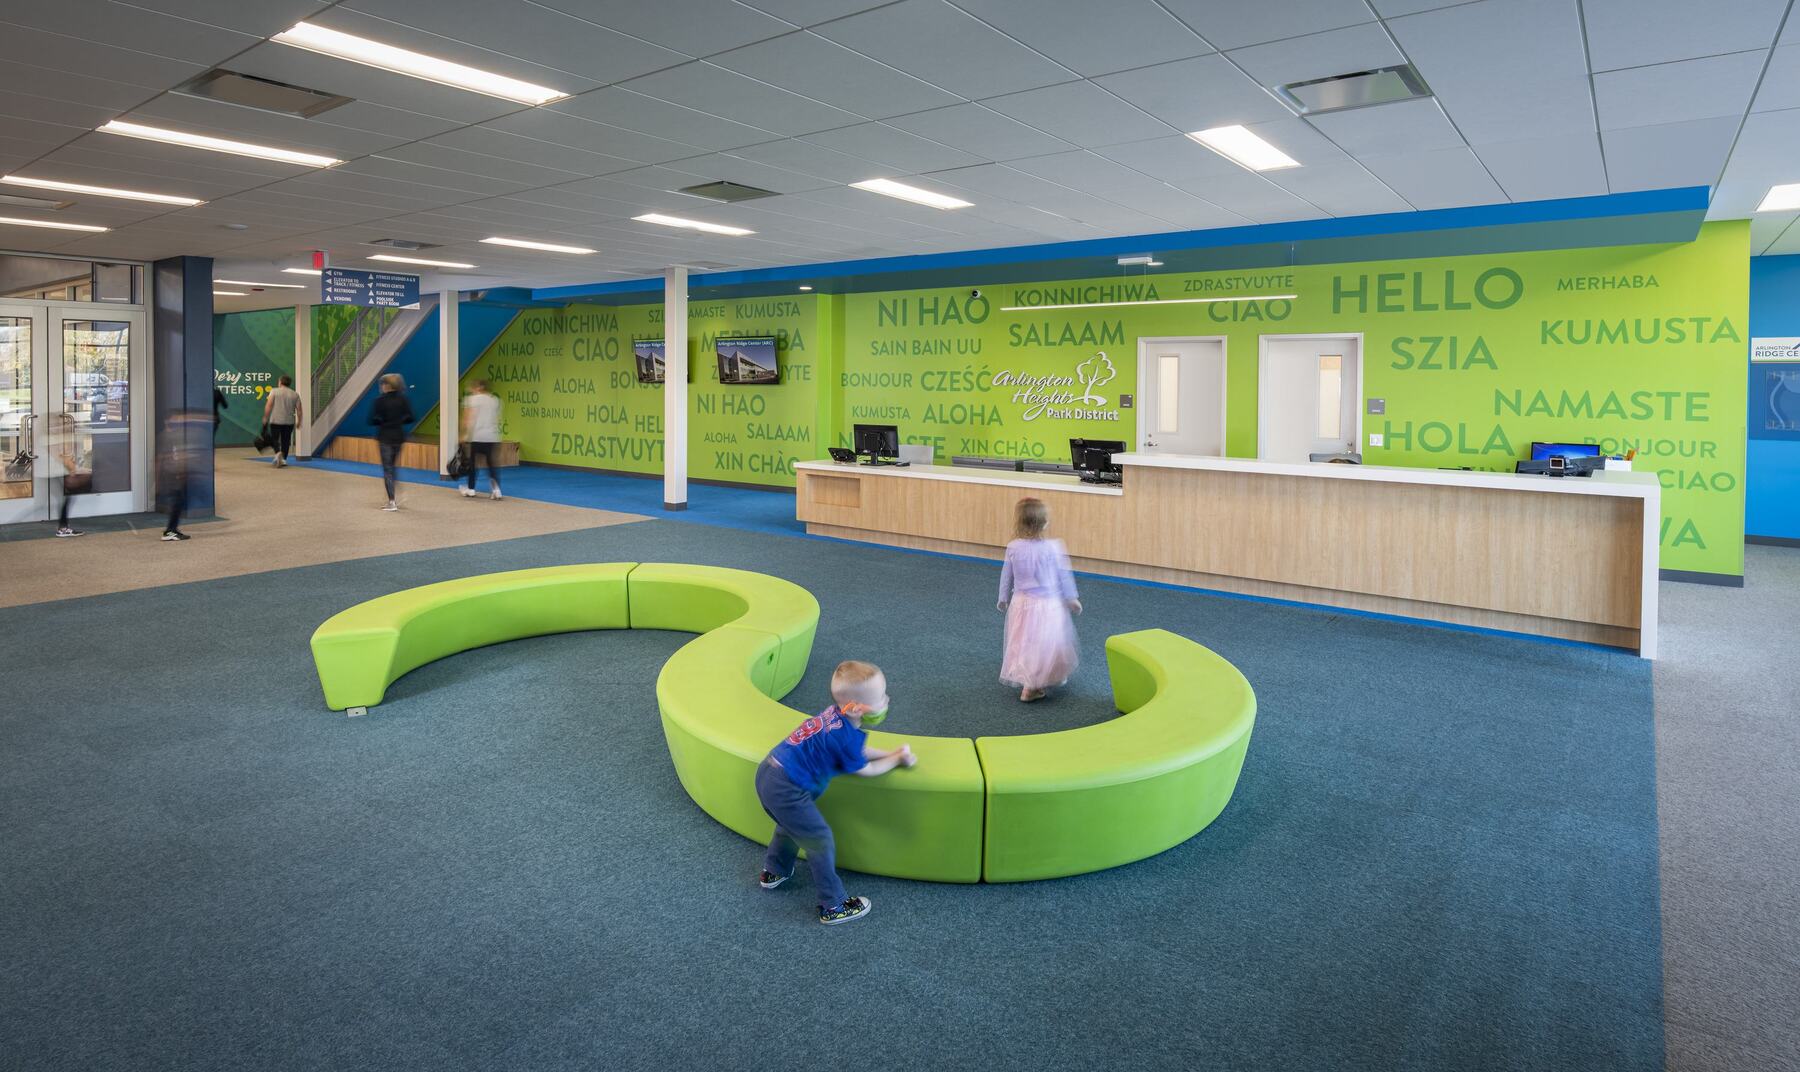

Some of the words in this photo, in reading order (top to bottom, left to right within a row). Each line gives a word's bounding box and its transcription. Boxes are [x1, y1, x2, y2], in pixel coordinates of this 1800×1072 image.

[1184, 275, 1295, 292] ZDRASTVUYTE
[1332, 266, 1524, 314] HELLO
[1557, 275, 1660, 291] MERHABA
[1014, 283, 1161, 307] KONNICHIWA
[648, 309, 665, 323] SZI
[688, 305, 726, 319] AMASTE
[736, 302, 801, 319] KUMUSTA
[878, 298, 908, 327] NI
[919, 295, 990, 325] HAO
[1208, 298, 1292, 322] CIAO
[523, 314, 619, 335] KONNICHIWA
[1009, 320, 1125, 347] SALAAM
[1541, 316, 1741, 345] KUMUSTA
[498, 343, 509, 356] NI
[512, 342, 535, 356] HAO
[572, 337, 619, 361] CIAO
[871, 340, 907, 355] SAIN
[912, 339, 952, 355] BAIN
[957, 338, 982, 354] UU
[1391, 335, 1498, 370] SZIA
[245, 372, 272, 382] STEP
[488, 364, 541, 383] SALAAM
[841, 372, 913, 388] BONJOUR
[920, 365, 992, 392] CZEŚĆ
[992, 369, 1075, 393] Arlington
[553, 378, 596, 394] ALOHA
[508, 391, 540, 404] HALLO
[697, 394, 716, 414] NI
[722, 394, 766, 416] HAO
[1011, 386, 1075, 421] Heights
[1494, 388, 1711, 422] NAMASTE
[521, 407, 540, 418] SAIN
[541, 408, 561, 419] BAIN
[562, 408, 575, 419] UU
[587, 405, 629, 424] HOLA
[852, 405, 911, 420] KUMUSTA
[922, 403, 1004, 426] ALOHA
[1047, 408, 1073, 420] Park
[1075, 409, 1119, 421] District
[635, 415, 664, 433] HEL
[747, 422, 810, 442] SALAAM
[551, 433, 665, 462] ZDRASTVUYT
[704, 432, 738, 443] ALOHA
[961, 438, 989, 454] XIN
[994, 436, 1046, 458] CHÀO
[1384, 420, 1516, 457] HOLA
[715, 451, 744, 471] XIN
[1657, 469, 1736, 492] CIAO
